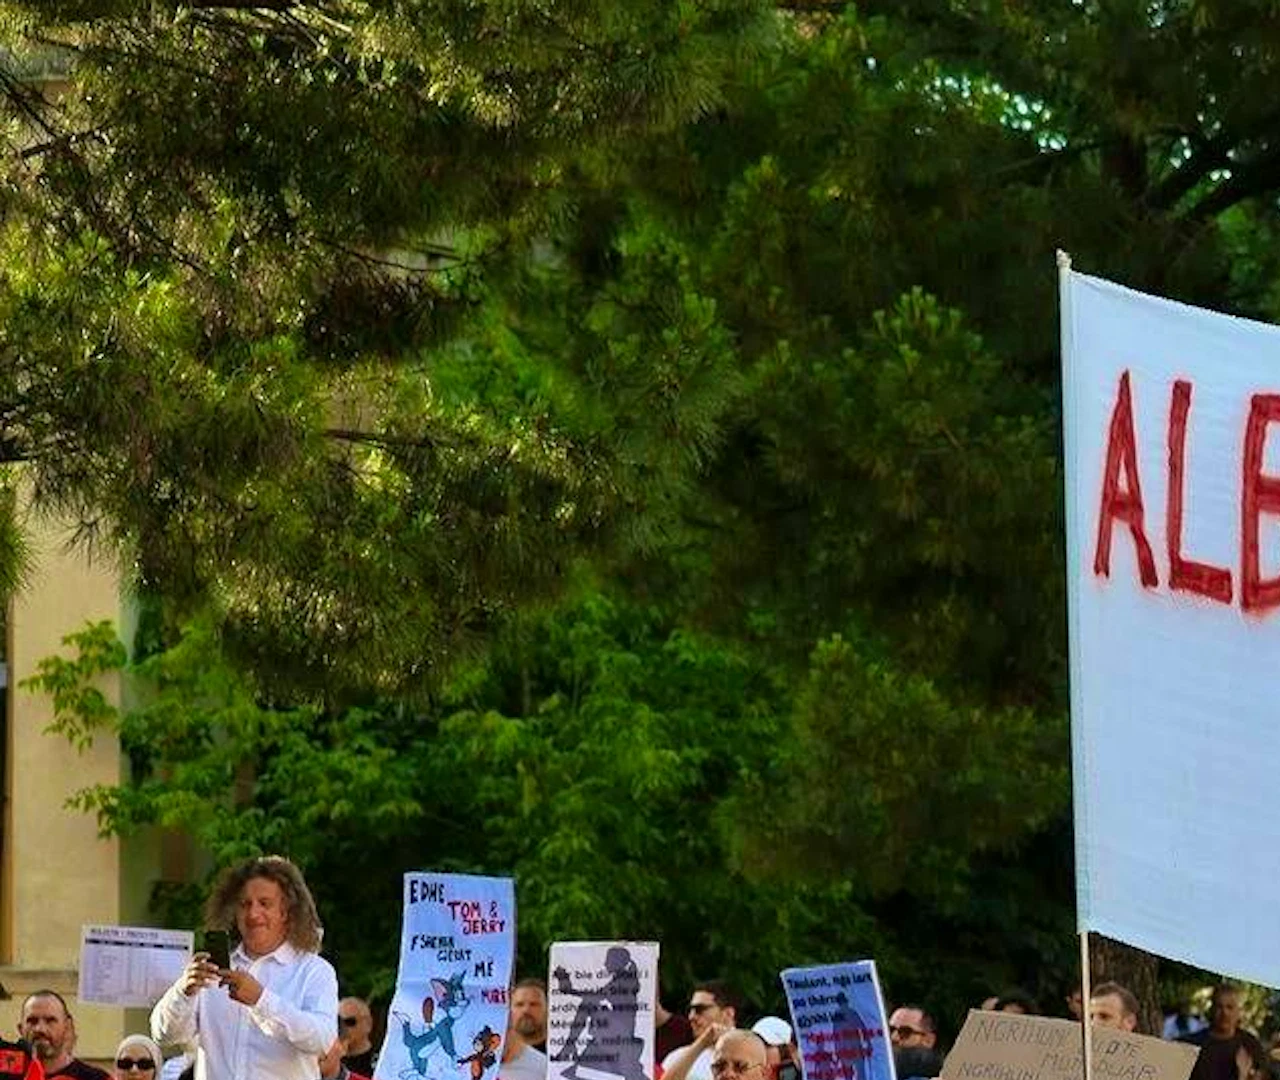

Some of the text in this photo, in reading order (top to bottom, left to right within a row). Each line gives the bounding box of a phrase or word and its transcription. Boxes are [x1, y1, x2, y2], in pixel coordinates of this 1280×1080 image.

[410, 879, 445, 904] EDHE
[447, 900, 498, 921] TOM &
[462, 919, 506, 935] JERRY
